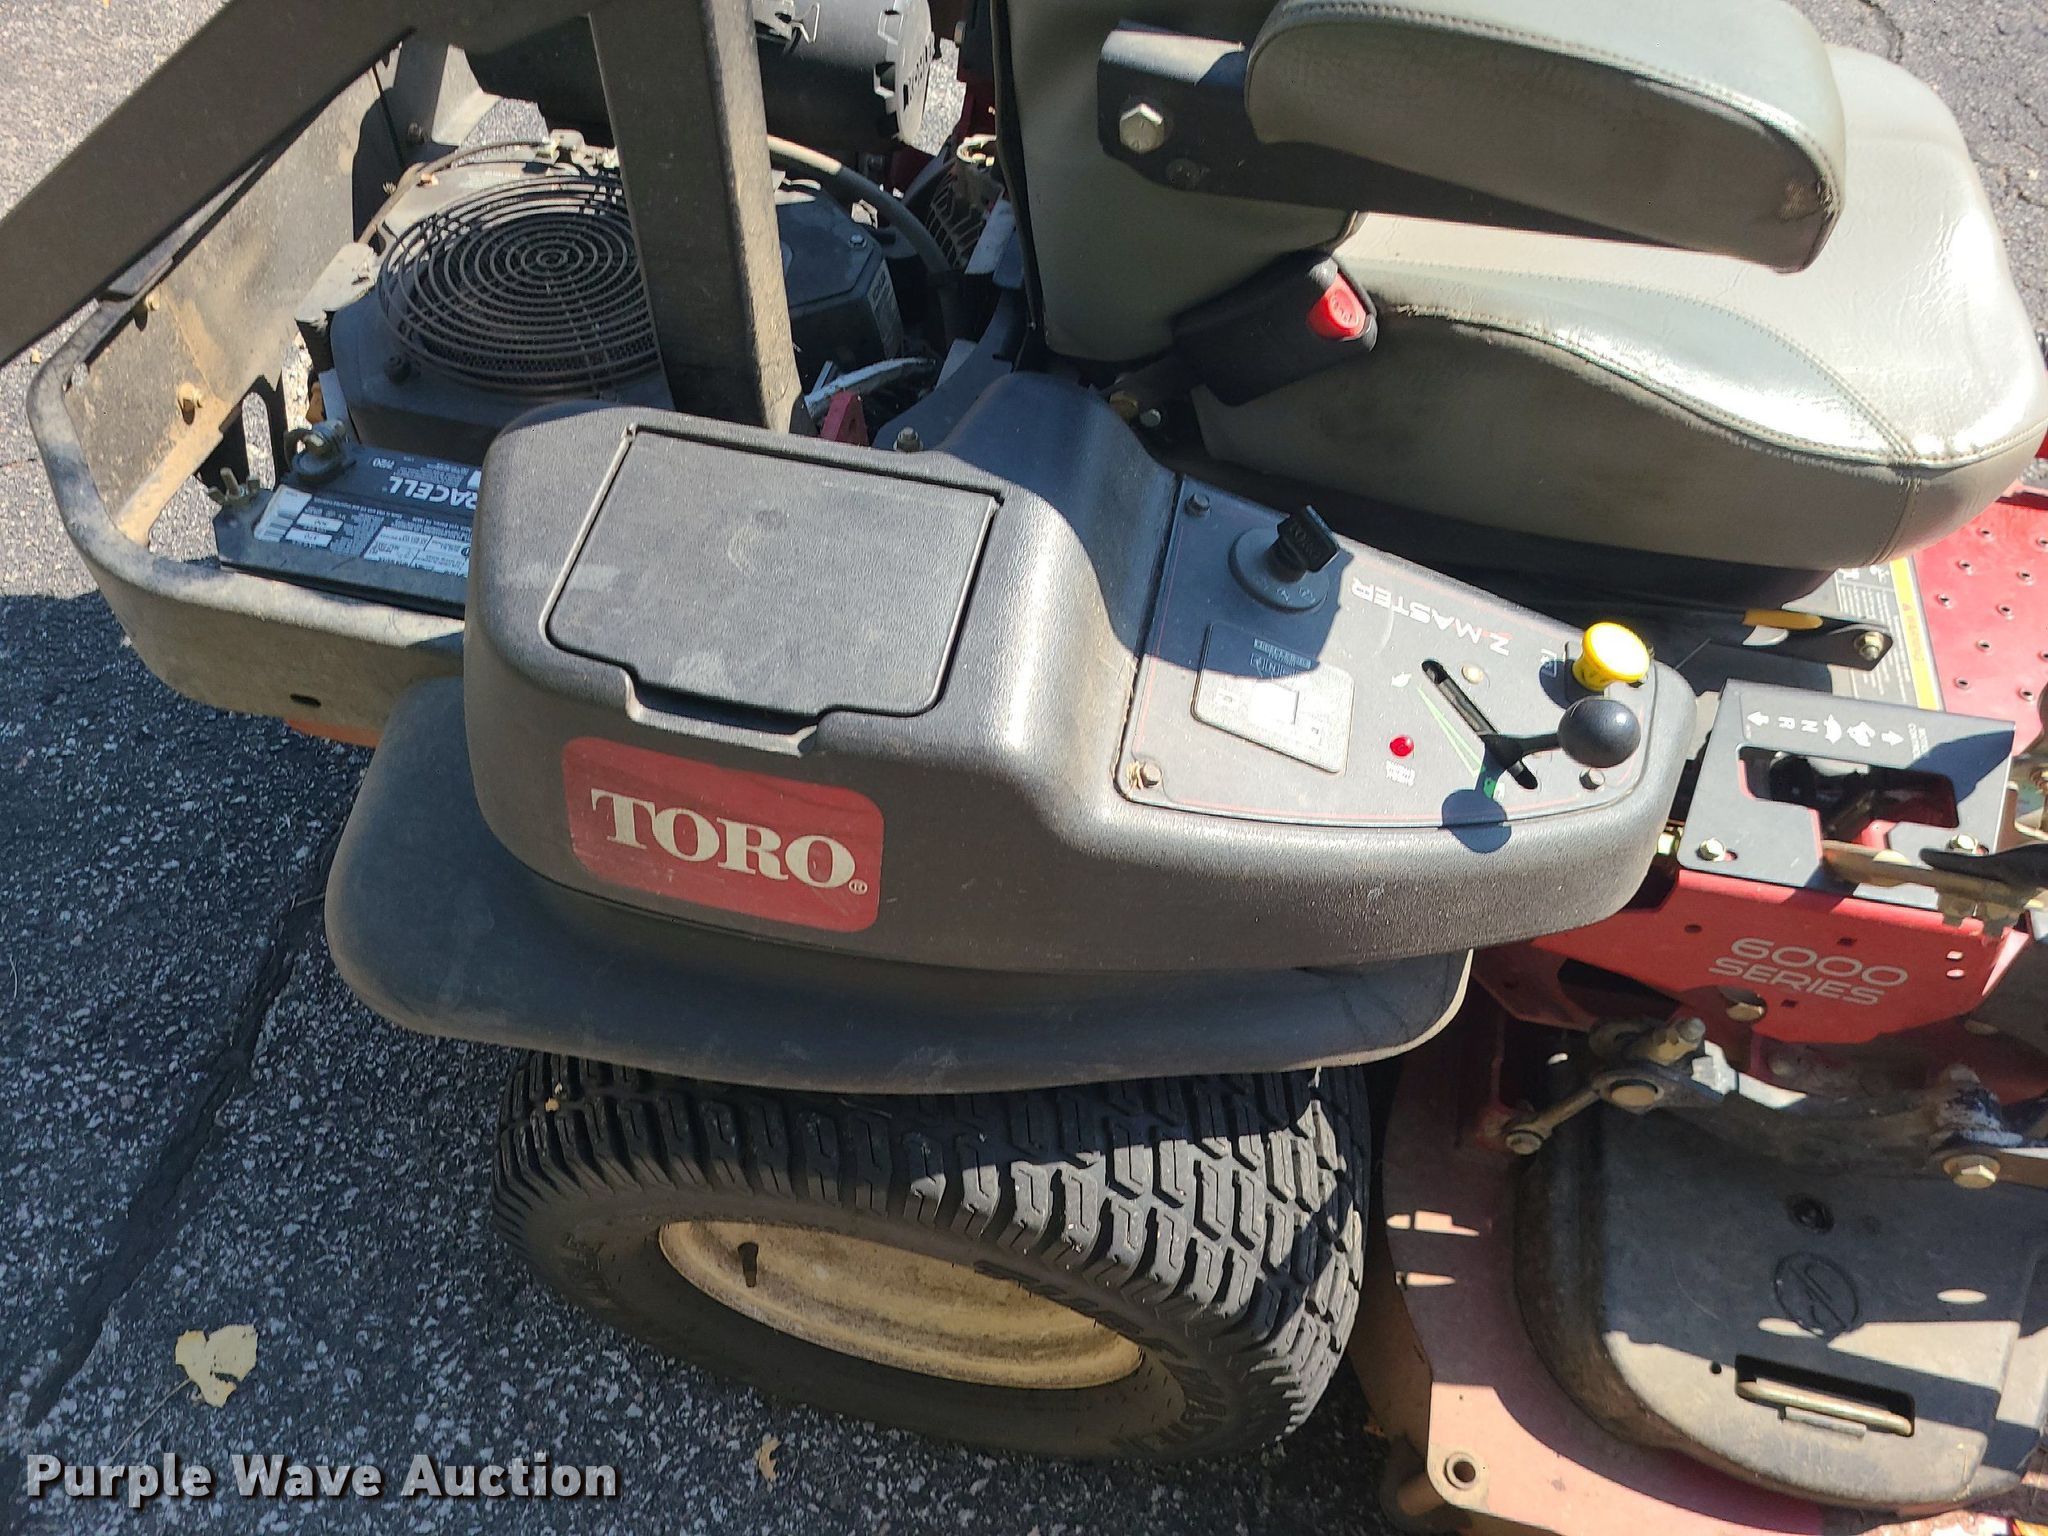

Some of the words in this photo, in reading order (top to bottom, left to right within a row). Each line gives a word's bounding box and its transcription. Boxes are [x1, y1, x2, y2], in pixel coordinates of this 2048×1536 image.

[1352, 577, 1482, 644] MASTER
[1489, 632, 1510, 656] Z
[1778, 716, 1796, 730] R
[1801, 719, 1818, 733] N
[1731, 937, 1909, 987] 6000
[1708, 957, 1885, 1006] SERIES
